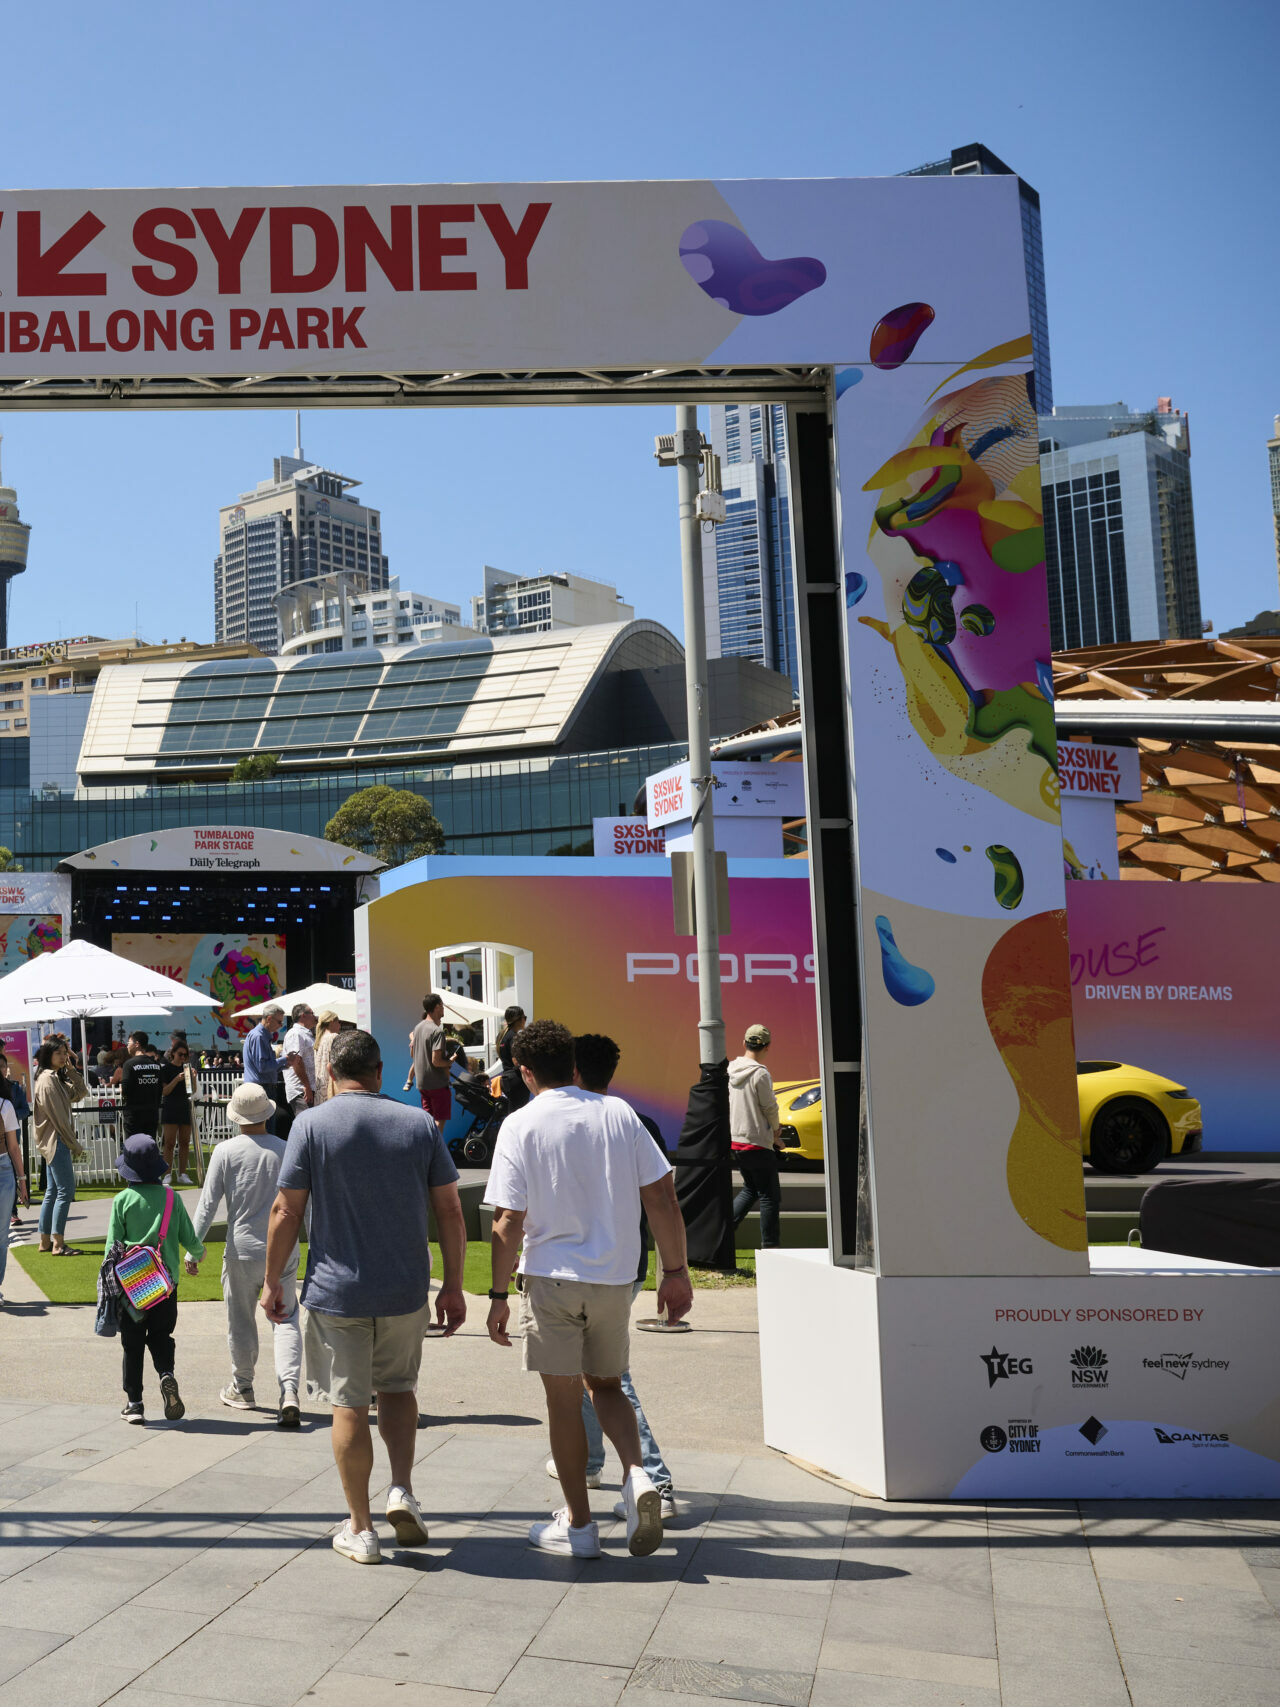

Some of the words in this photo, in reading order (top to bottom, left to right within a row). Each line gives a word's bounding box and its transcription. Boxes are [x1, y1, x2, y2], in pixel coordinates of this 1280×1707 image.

[131, 203, 554, 297] SYDNEY
[228, 306, 368, 351] PARK
[1057, 746, 1101, 770] SXSW
[1058, 769, 1122, 794] SYDNEY
[653, 780, 676, 800] SXSW
[654, 792, 684, 818] SYDNEY
[193, 830, 255, 840] TUMBALONG
[194, 840, 221, 850] PARK
[222, 840, 254, 850] STAGE
[190, 857, 215, 869] Daily
[215, 857, 261, 869] Telegraph
[626, 952, 815, 983] POR
[23, 990, 174, 1005] PORSCHE
[1085, 984, 1142, 1000] DRIVEN
[1145, 985, 1165, 1000] BY
[1168, 986, 1233, 1001] DREAMS
[995, 1308, 1071, 1322] PROUDLY
[1075, 1308, 1179, 1322] SPONSORED
[1183, 1308, 1205, 1321] BY
[1142, 1358, 1164, 1368] feel
[1166, 1360, 1190, 1368] new
[1191, 1358, 1230, 1371] sydney
[1071, 1370, 1109, 1383] NSW
[1008, 1425, 1027, 1439] CITY
[1028, 1425, 1039, 1438] OF
[1171, 1433, 1230, 1442] QANTAS
[1009, 1440, 1041, 1453] SYDNEY
